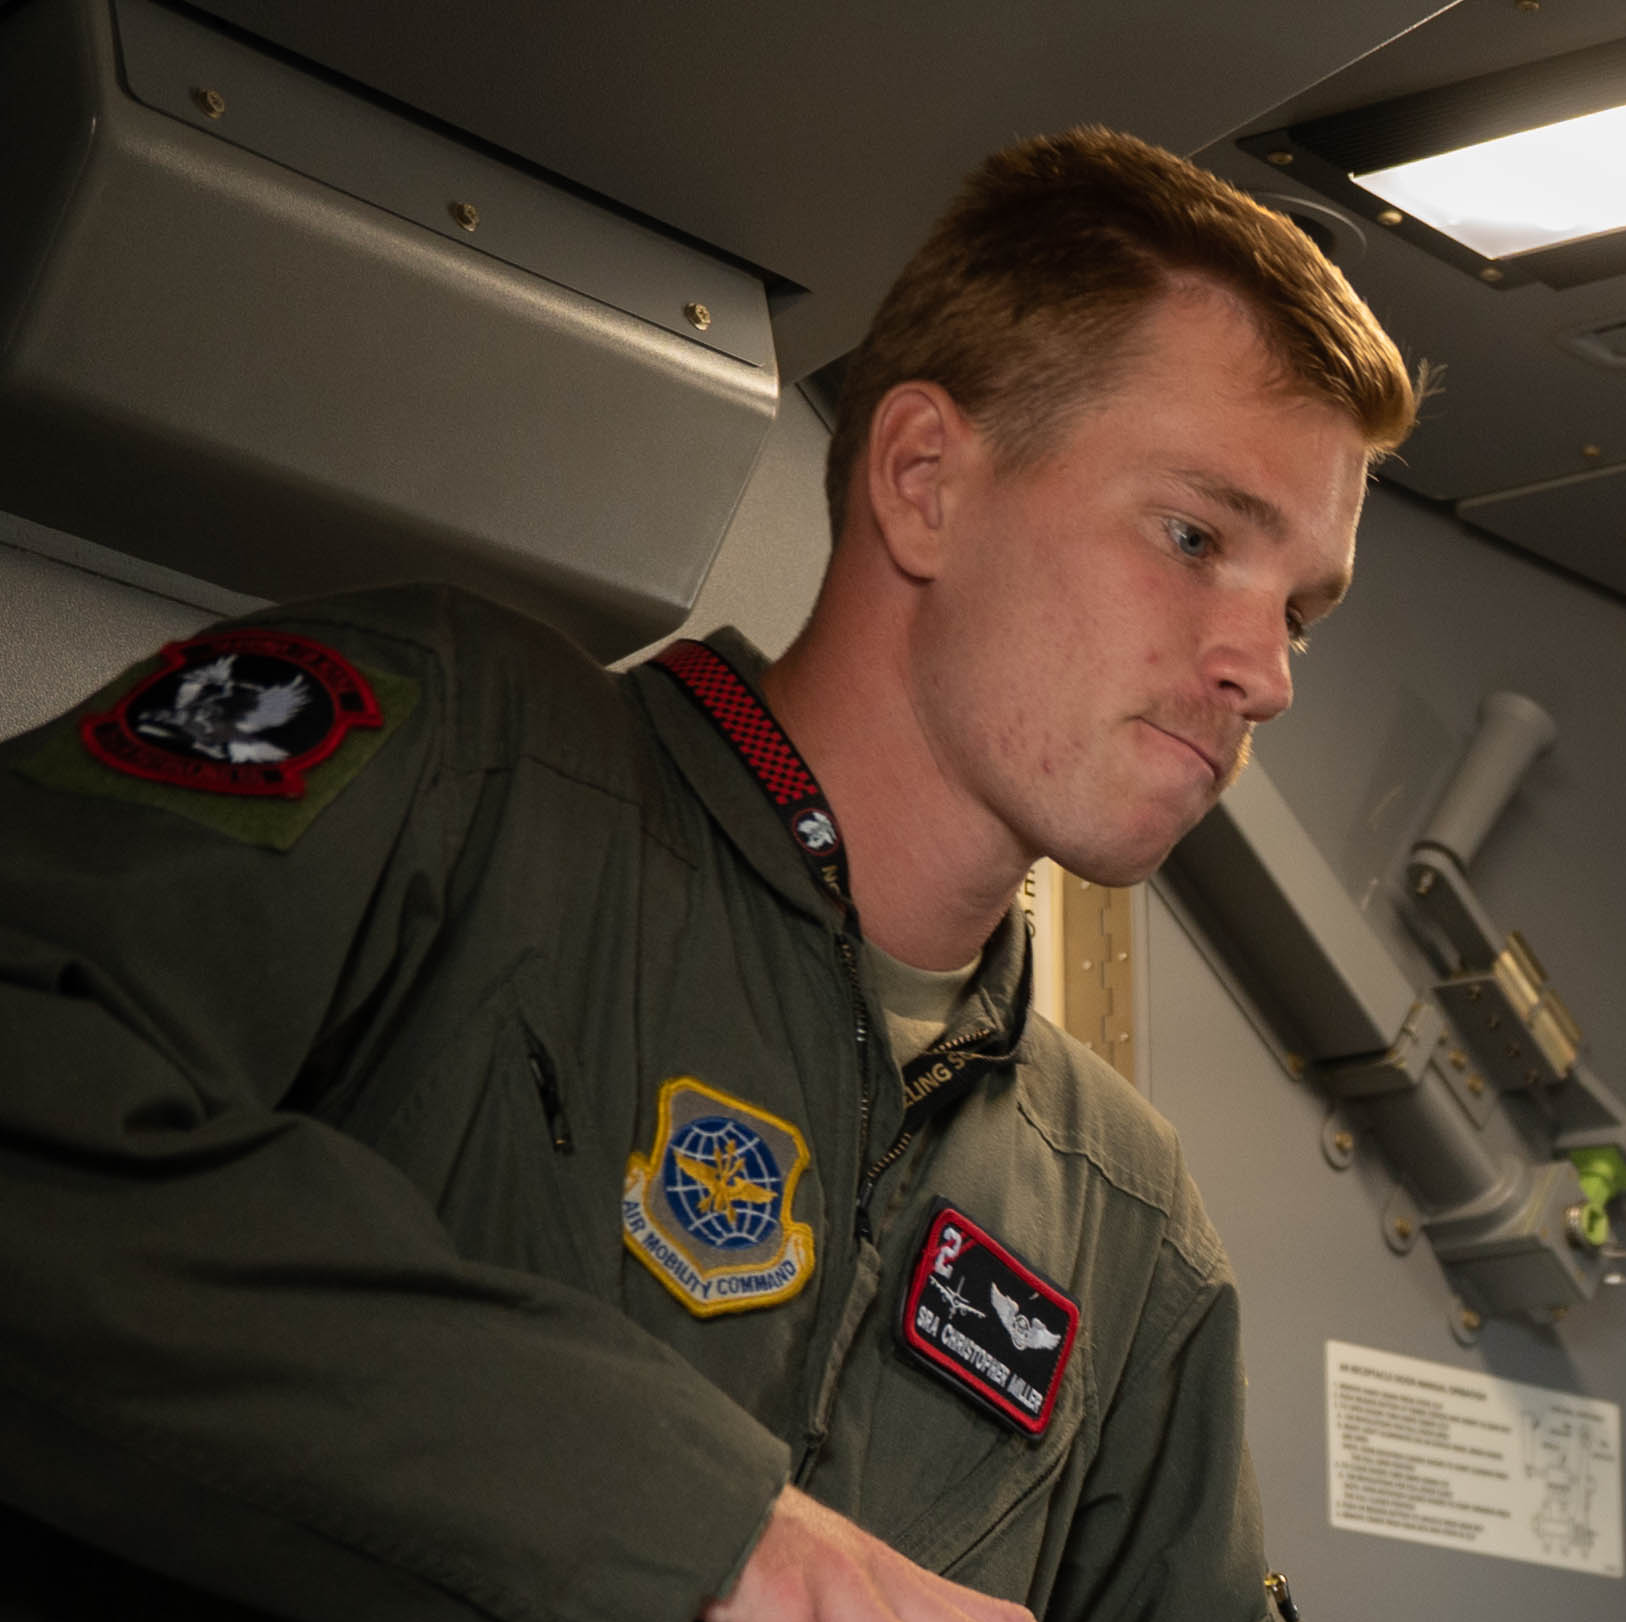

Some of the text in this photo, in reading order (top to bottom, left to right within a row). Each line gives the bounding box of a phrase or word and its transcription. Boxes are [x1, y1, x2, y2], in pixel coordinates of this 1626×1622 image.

[623, 1200, 797, 1299] AIR MOBILITY COMMAND
[934, 1227, 962, 1278] 2
[941, 1323, 1010, 1387] CHRISTOPHER
[1006, 1374, 1043, 1414] MILLER
